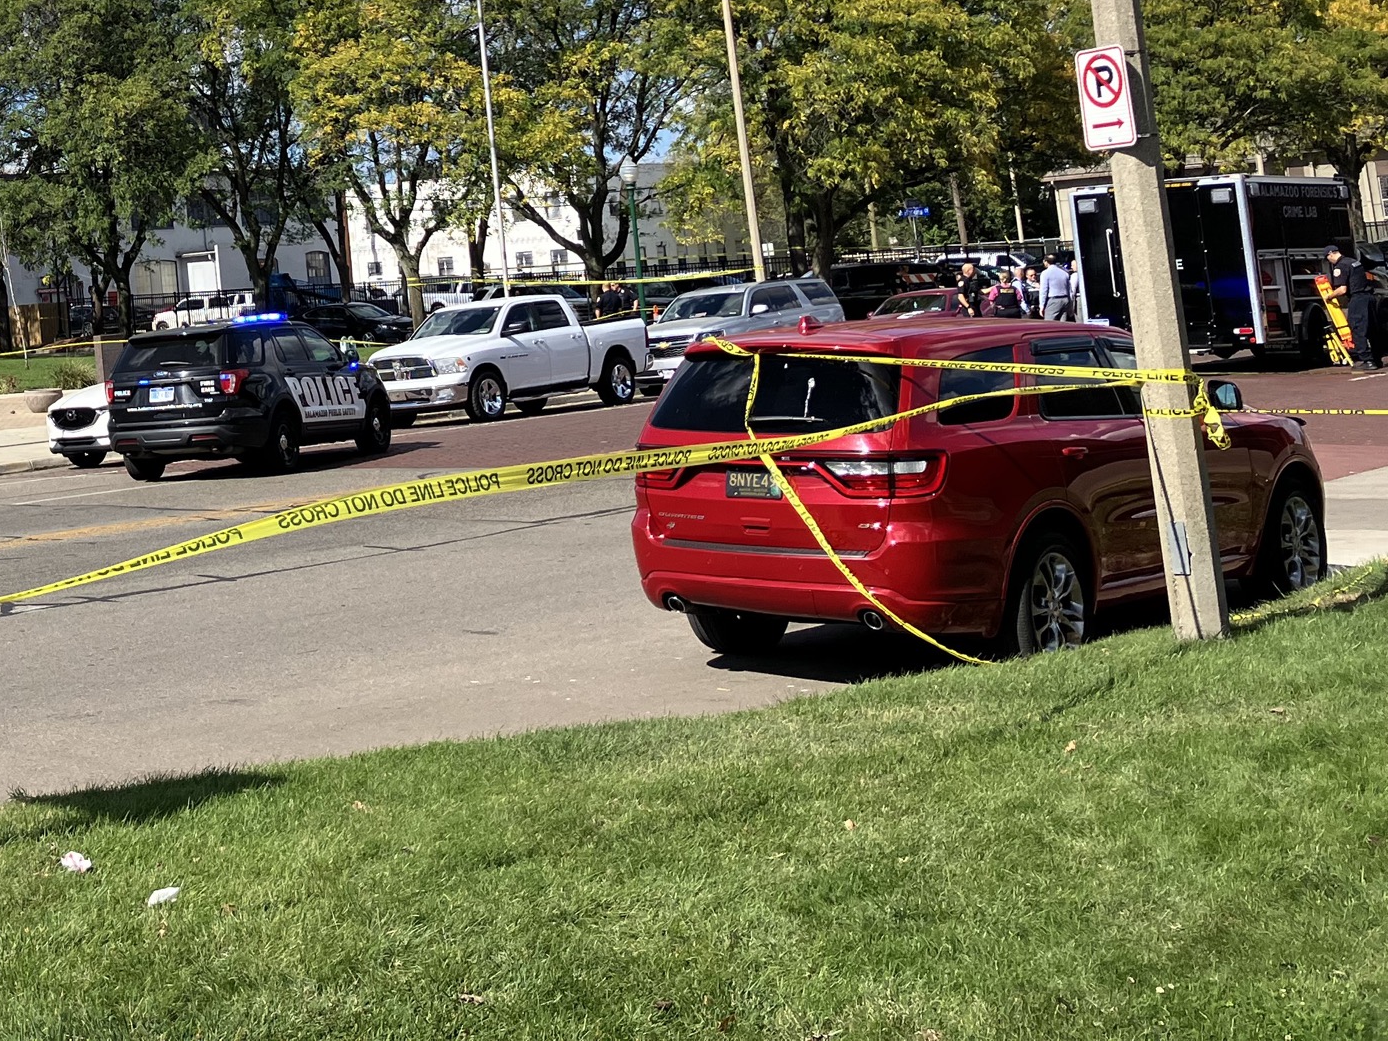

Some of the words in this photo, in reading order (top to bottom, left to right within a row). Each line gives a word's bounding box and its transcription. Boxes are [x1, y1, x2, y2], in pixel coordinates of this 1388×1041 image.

[1259, 184, 1300, 198] ALAMAZOO
[1301, 185, 1338, 198] FORENSICS
[1282, 205, 1304, 218] CRIME
[1304, 205, 1318, 218] LAB
[284, 376, 365, 407] POLICE
